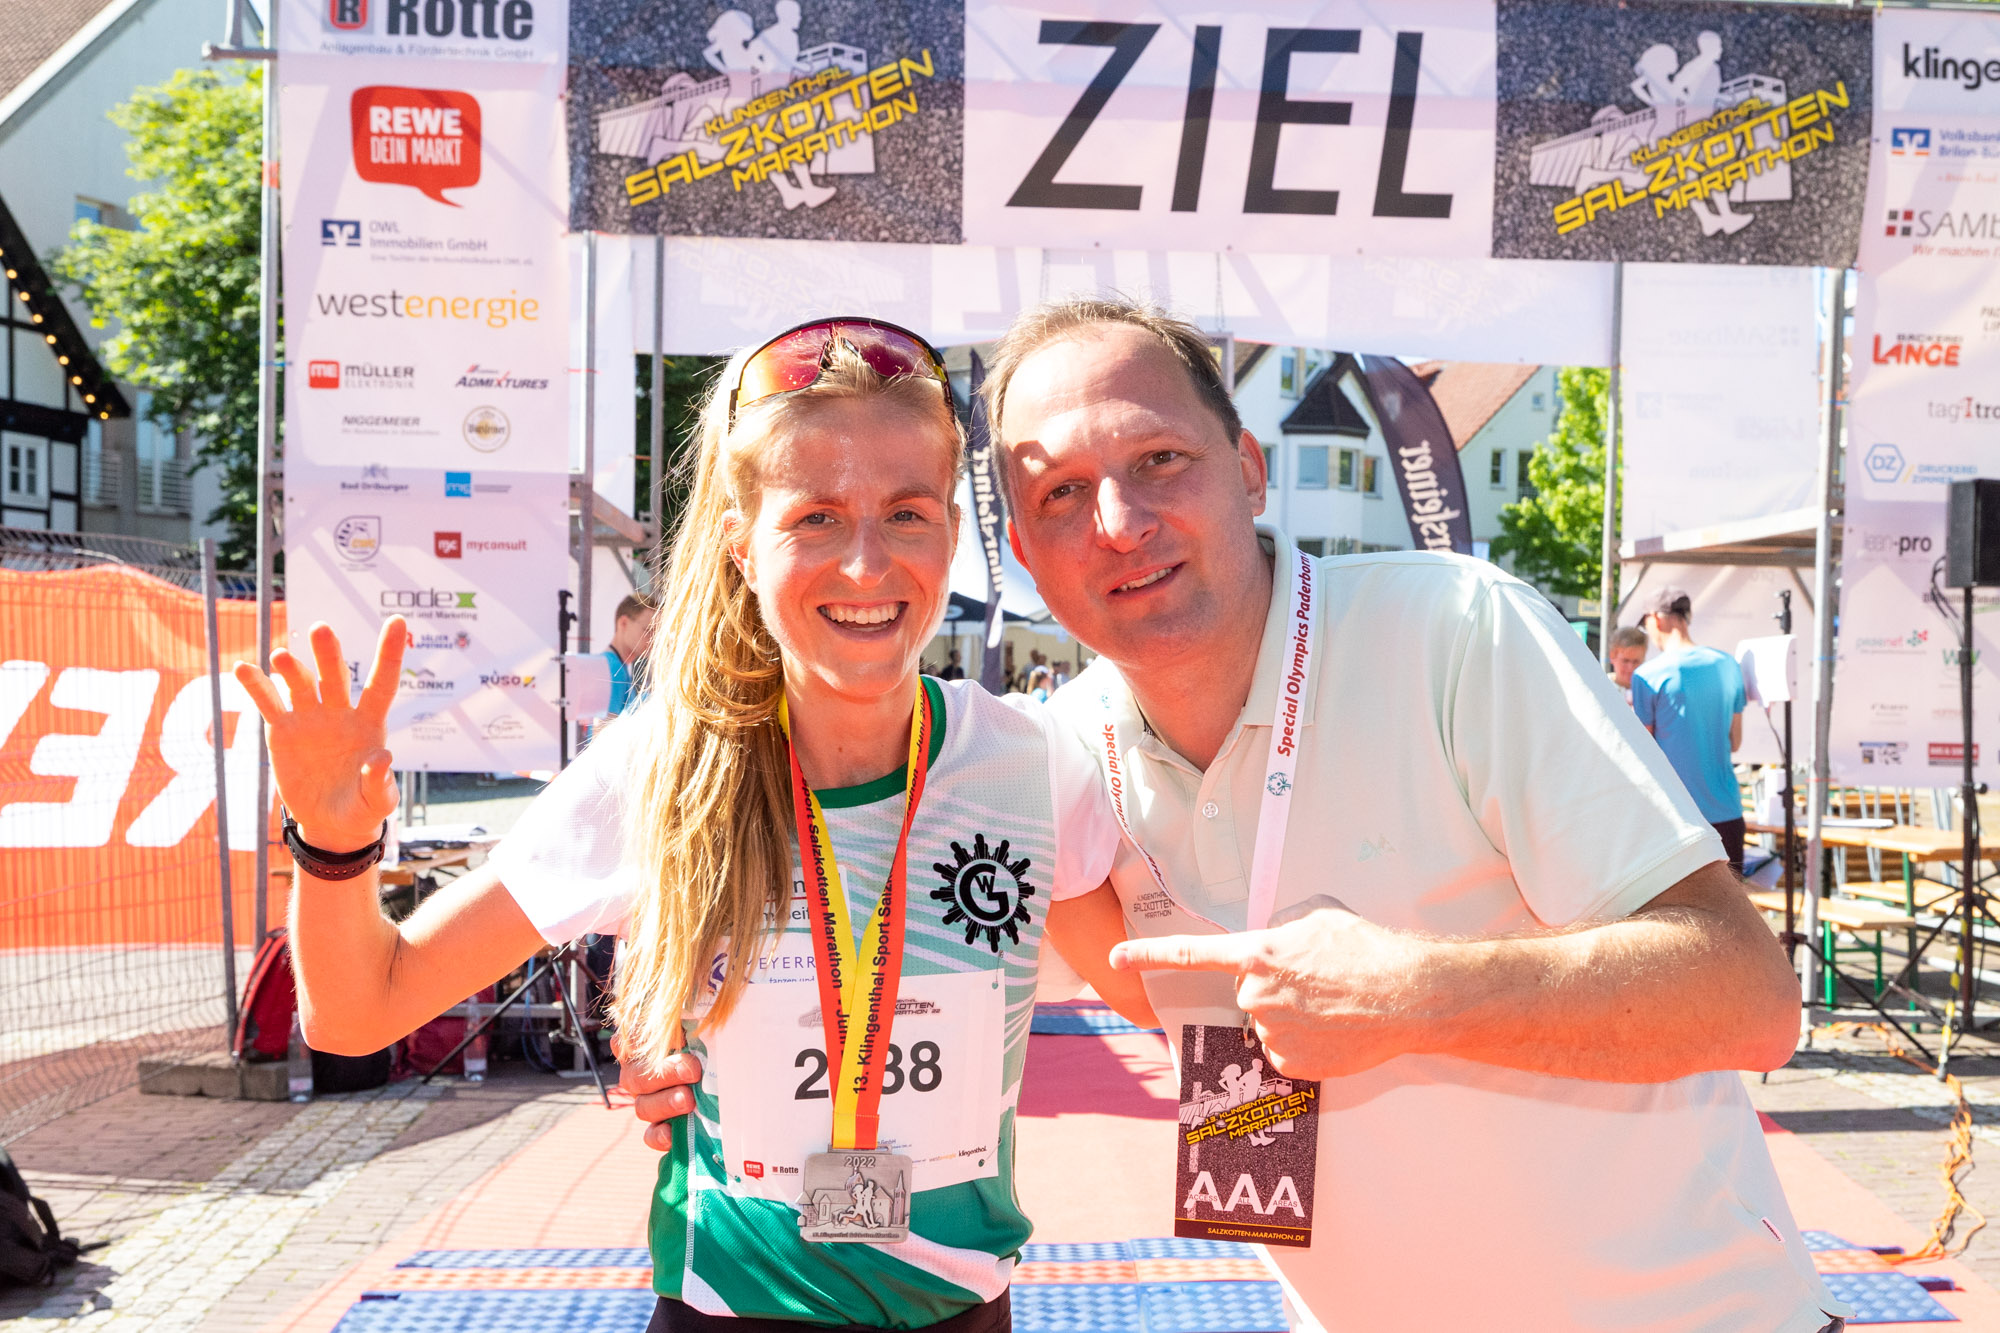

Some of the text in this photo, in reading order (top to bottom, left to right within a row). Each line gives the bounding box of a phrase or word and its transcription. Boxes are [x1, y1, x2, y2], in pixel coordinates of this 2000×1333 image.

[704, 65, 852, 136] KLINGENTHAL
[369, 106, 463, 136] REWE
[624, 48, 935, 207] SALZKOTTEN
[1005, 19, 1454, 219] ZIEL
[1630, 97, 1773, 166] KLINGENTHAL
[370, 137, 463, 166] DEIN MARKT
[732, 92, 919, 192] MARATHON
[1553, 80, 1850, 235] SALZKOTTEN
[1653, 122, 1835, 219] MARATHON
[370, 236, 488, 251] Immobilien GmbH
[317, 289, 539, 329] westenergie
[1873, 334, 1961, 367] LANGE
[342, 415, 421, 426] NIGGEMEIER
[1872, 455, 1896, 471] DZ
[466, 539, 527, 552] myconsult
[435, 611, 478, 621] Marketing
[1276, 553, 1312, 758] Special Olympics Paderborn
[1102, 723, 1122, 776] Special
[808, 823, 831, 907] Salzkotten
[822, 911, 843, 990] Marathon
[872, 921, 892, 969] Sport
[856, 972, 886, 1066] Klingenthal
[895, 1001, 935, 1011] KOTTEN
[852, 1071, 870, 1095] 13.
[1185, 1087, 1316, 1145] SALZKOTTEN
[1219, 1093, 1281, 1120] KLINGENTHAL
[1229, 1104, 1308, 1141] MARATHON
[780, 1166, 799, 1174] Rotte
[844, 1156, 876, 1168] 2022
[1188, 1193, 1219, 1202] ACCESS
[1272, 1199, 1299, 1208] AREAS
